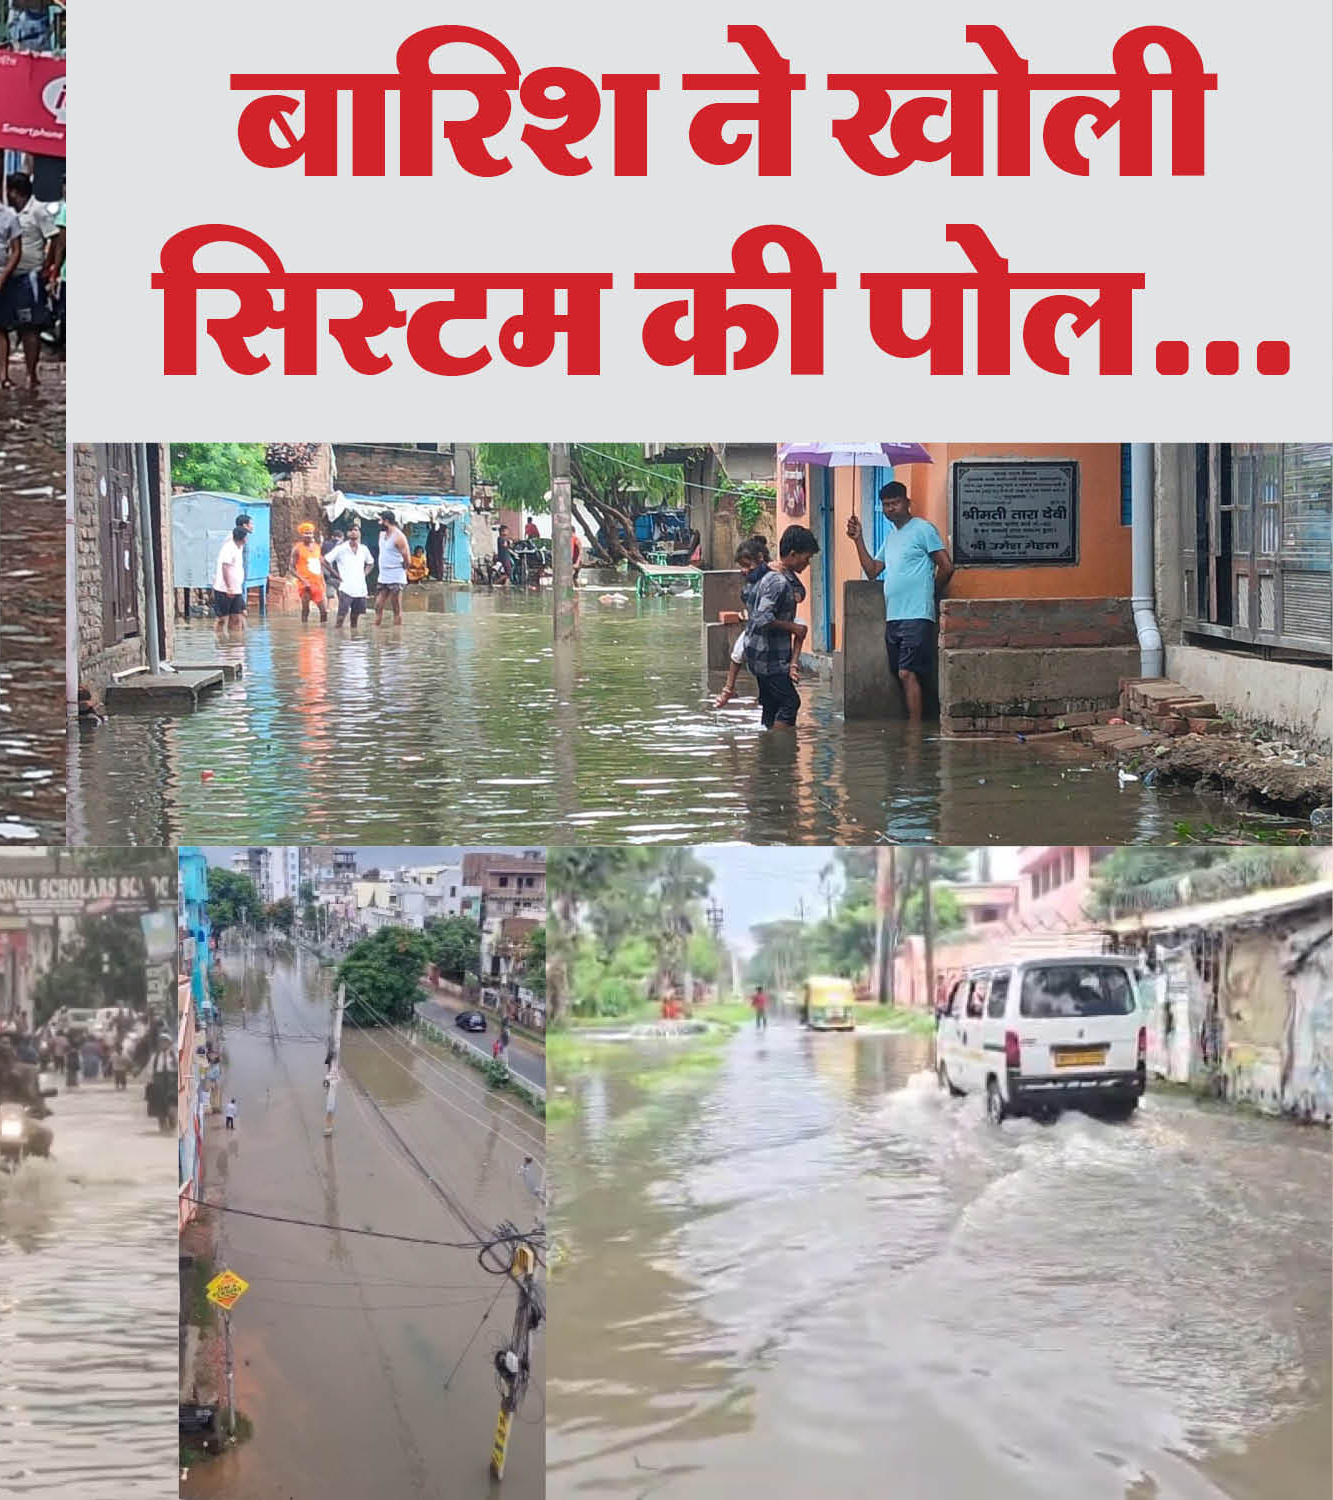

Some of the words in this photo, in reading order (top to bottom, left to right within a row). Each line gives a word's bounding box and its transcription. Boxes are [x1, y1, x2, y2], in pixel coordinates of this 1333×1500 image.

[2, 123, 64, 139] Smartphone
[962, 506, 1006, 520] श्रीमती
[1011, 508, 1038, 520] तारा
[1043, 506, 1068, 520] देवी
[40, 878, 115, 899] SCHOLARS
